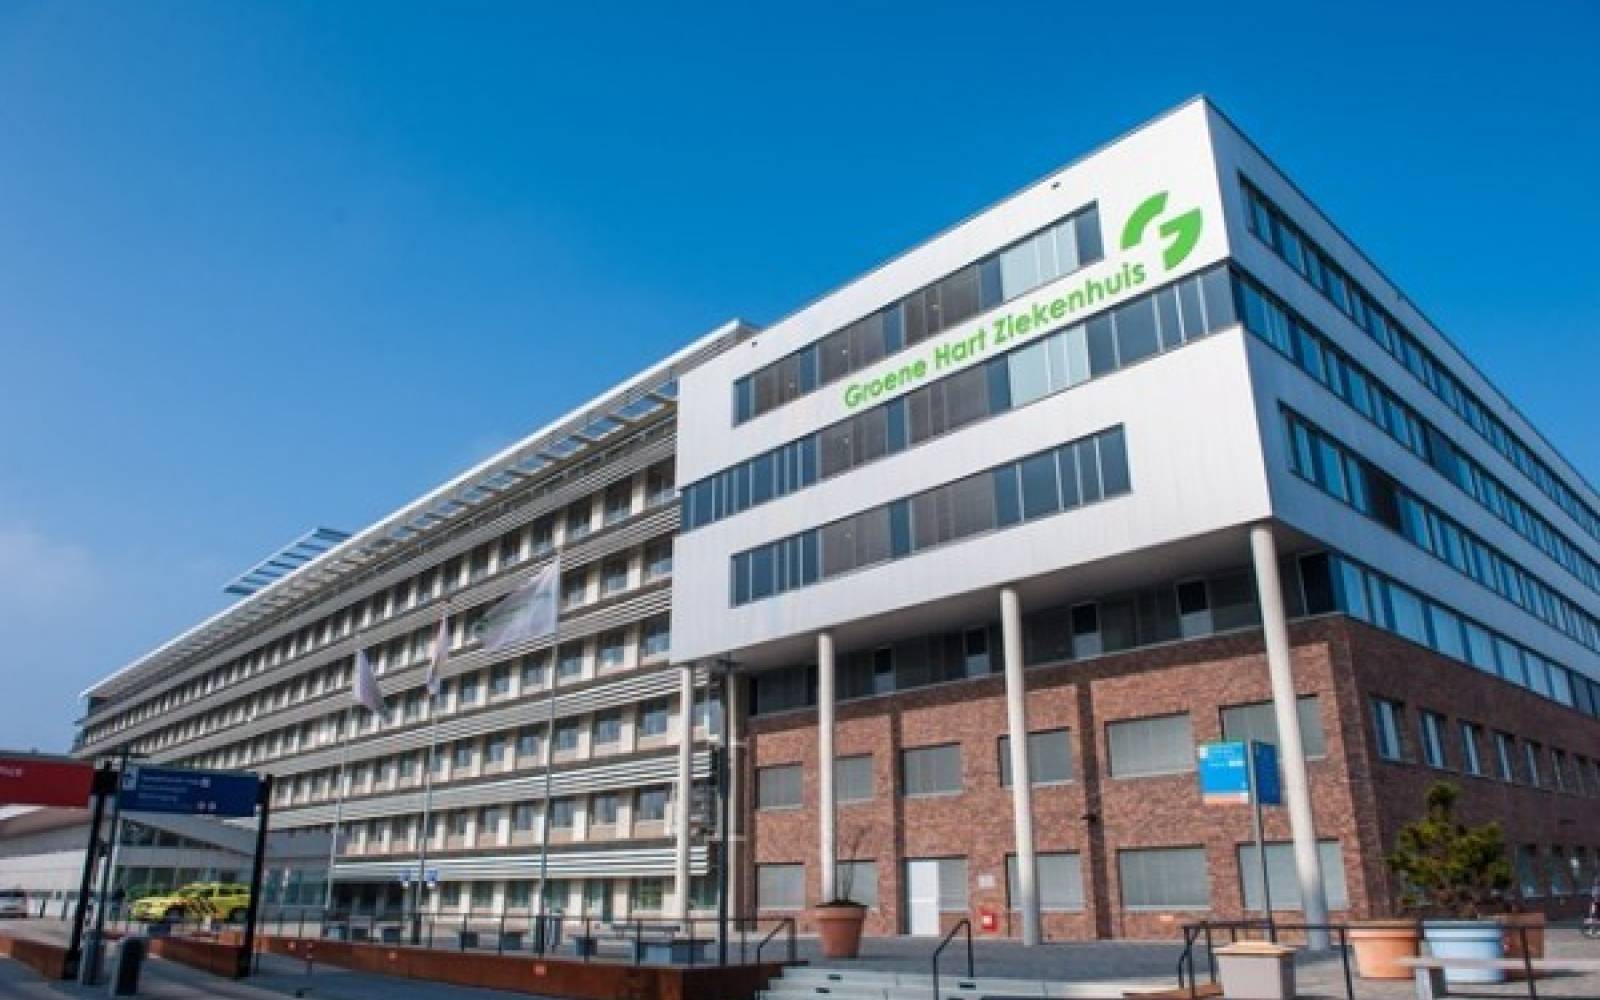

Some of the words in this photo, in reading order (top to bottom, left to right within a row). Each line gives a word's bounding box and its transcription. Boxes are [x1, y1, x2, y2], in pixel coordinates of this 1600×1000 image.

[844, 360, 927, 408] Groene
[934, 328, 985, 369] Hart
[992, 262, 1146, 345] Ziekenhuis
